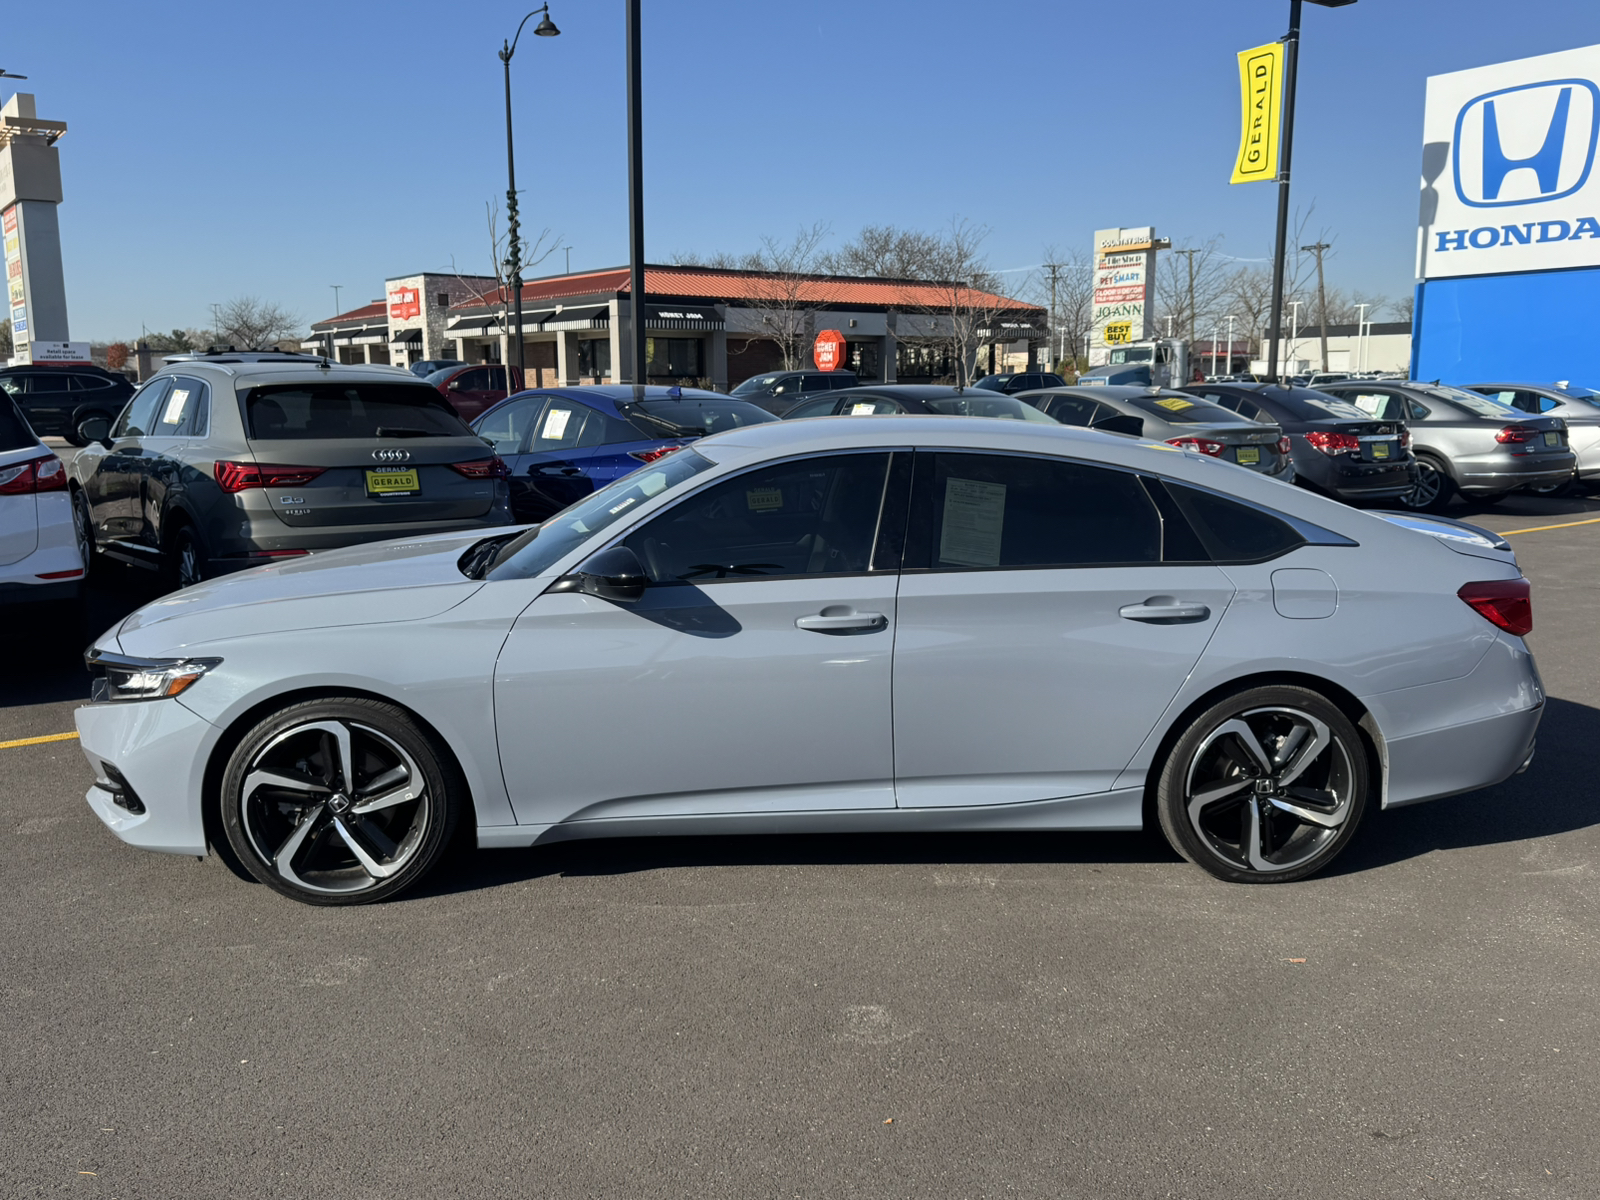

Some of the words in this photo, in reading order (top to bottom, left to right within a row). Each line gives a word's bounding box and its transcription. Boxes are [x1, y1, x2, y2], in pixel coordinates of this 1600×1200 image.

[1247, 65, 1267, 163] GERALD
[1435, 217, 1600, 252] HONDA
[1100, 273, 1139, 285] PETSMART
[1107, 325, 1130, 334] BEST
[1107, 333, 1127, 341] BUY
[373, 477, 412, 487] GERALD
[752, 496, 779, 504] GERALD
